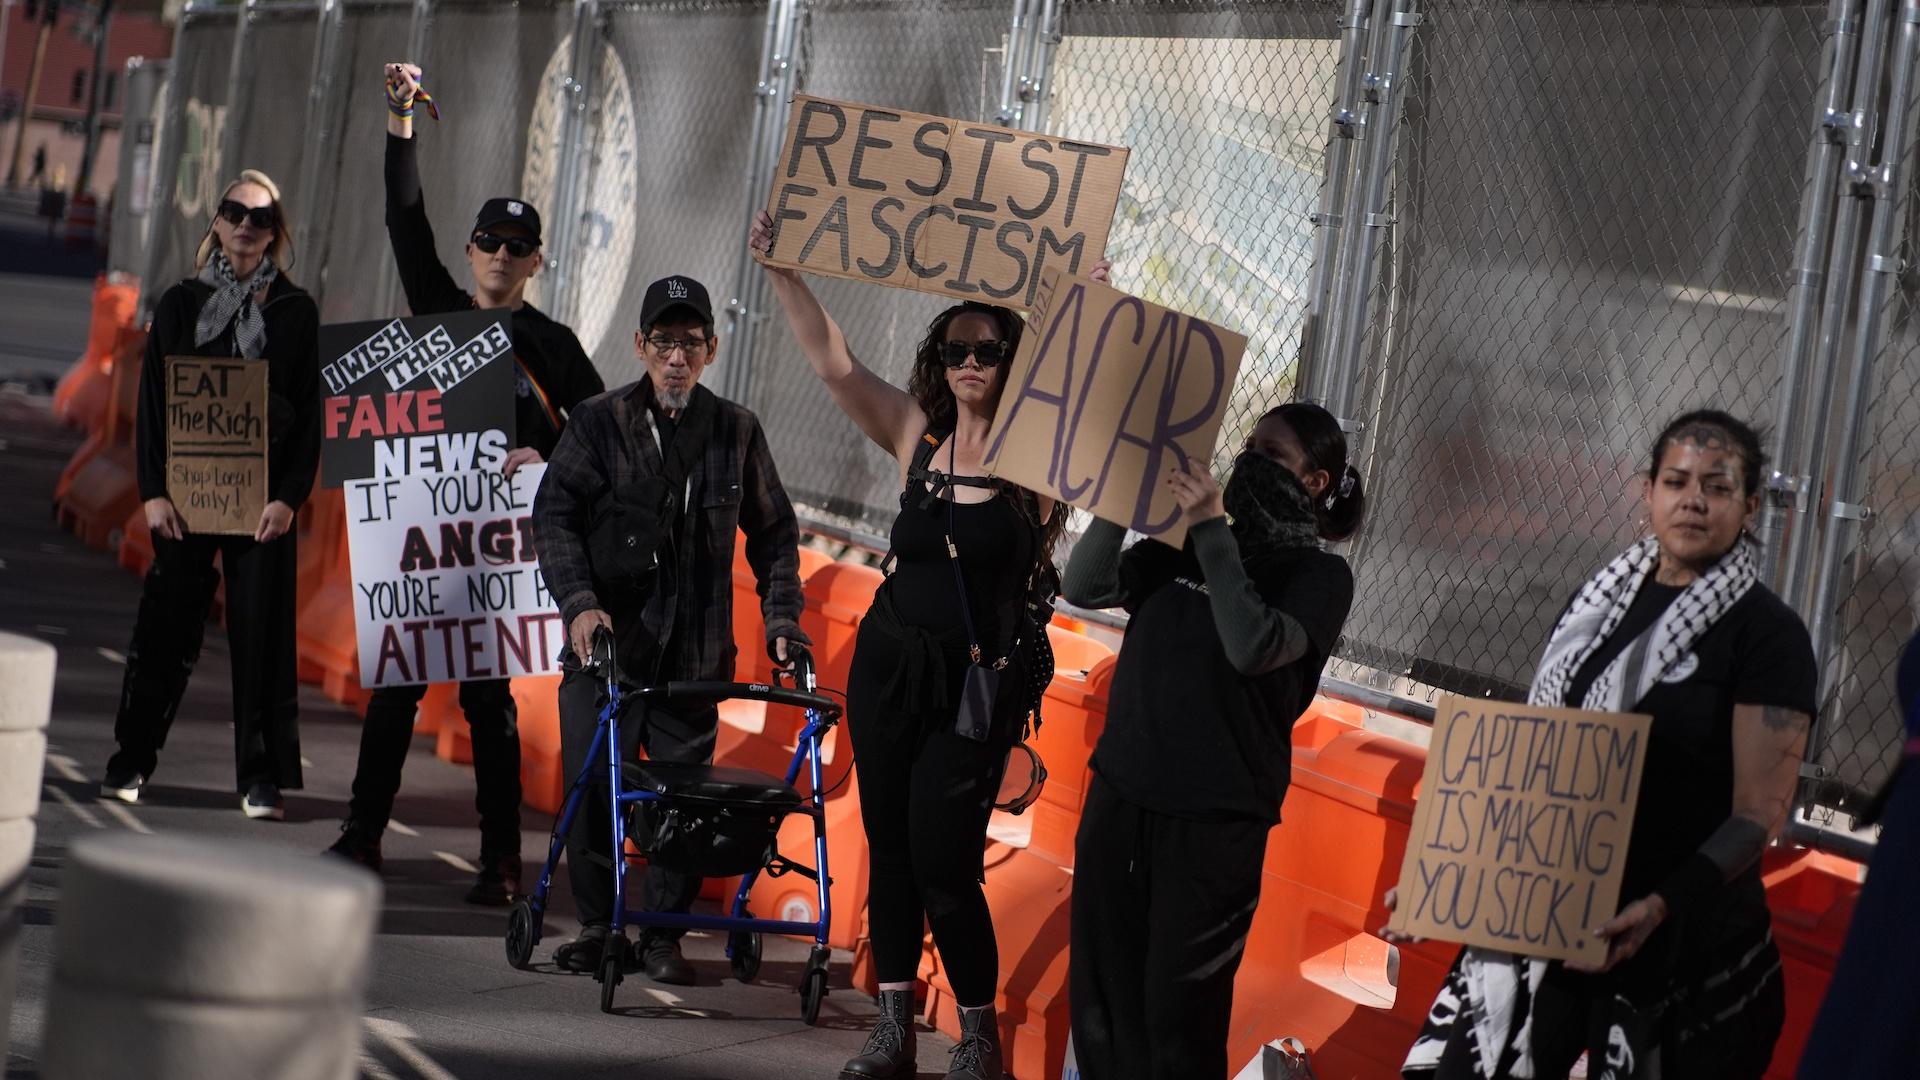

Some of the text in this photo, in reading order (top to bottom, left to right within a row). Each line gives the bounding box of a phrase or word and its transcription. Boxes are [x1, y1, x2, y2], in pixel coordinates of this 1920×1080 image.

[786, 100, 1112, 229] RESIST
[765, 183, 1087, 307] FASCISM
[173, 363, 245, 398] EAT
[323, 319, 413, 394] I WISH
[383, 327, 454, 388] THIS
[429, 323, 511, 392] WERE
[168, 400, 262, 439] The Rich
[324, 389, 445, 439] FAKE
[982, 283, 1225, 535] ACAB
[172, 463, 212, 489] Shop
[373, 429, 508, 478] NEWS
[355, 469, 528, 522] IF YOU'RE
[358, 573, 445, 621] YOU'RE
[467, 569, 524, 613] NOT
[374, 613, 568, 685] ATTENT
[749, 683, 770, 693] drive
[1441, 710, 1639, 804] CAPITALISM
[1426, 788, 1618, 876] IS MAKING
[1414, 858, 1596, 950] YOU SICK!
